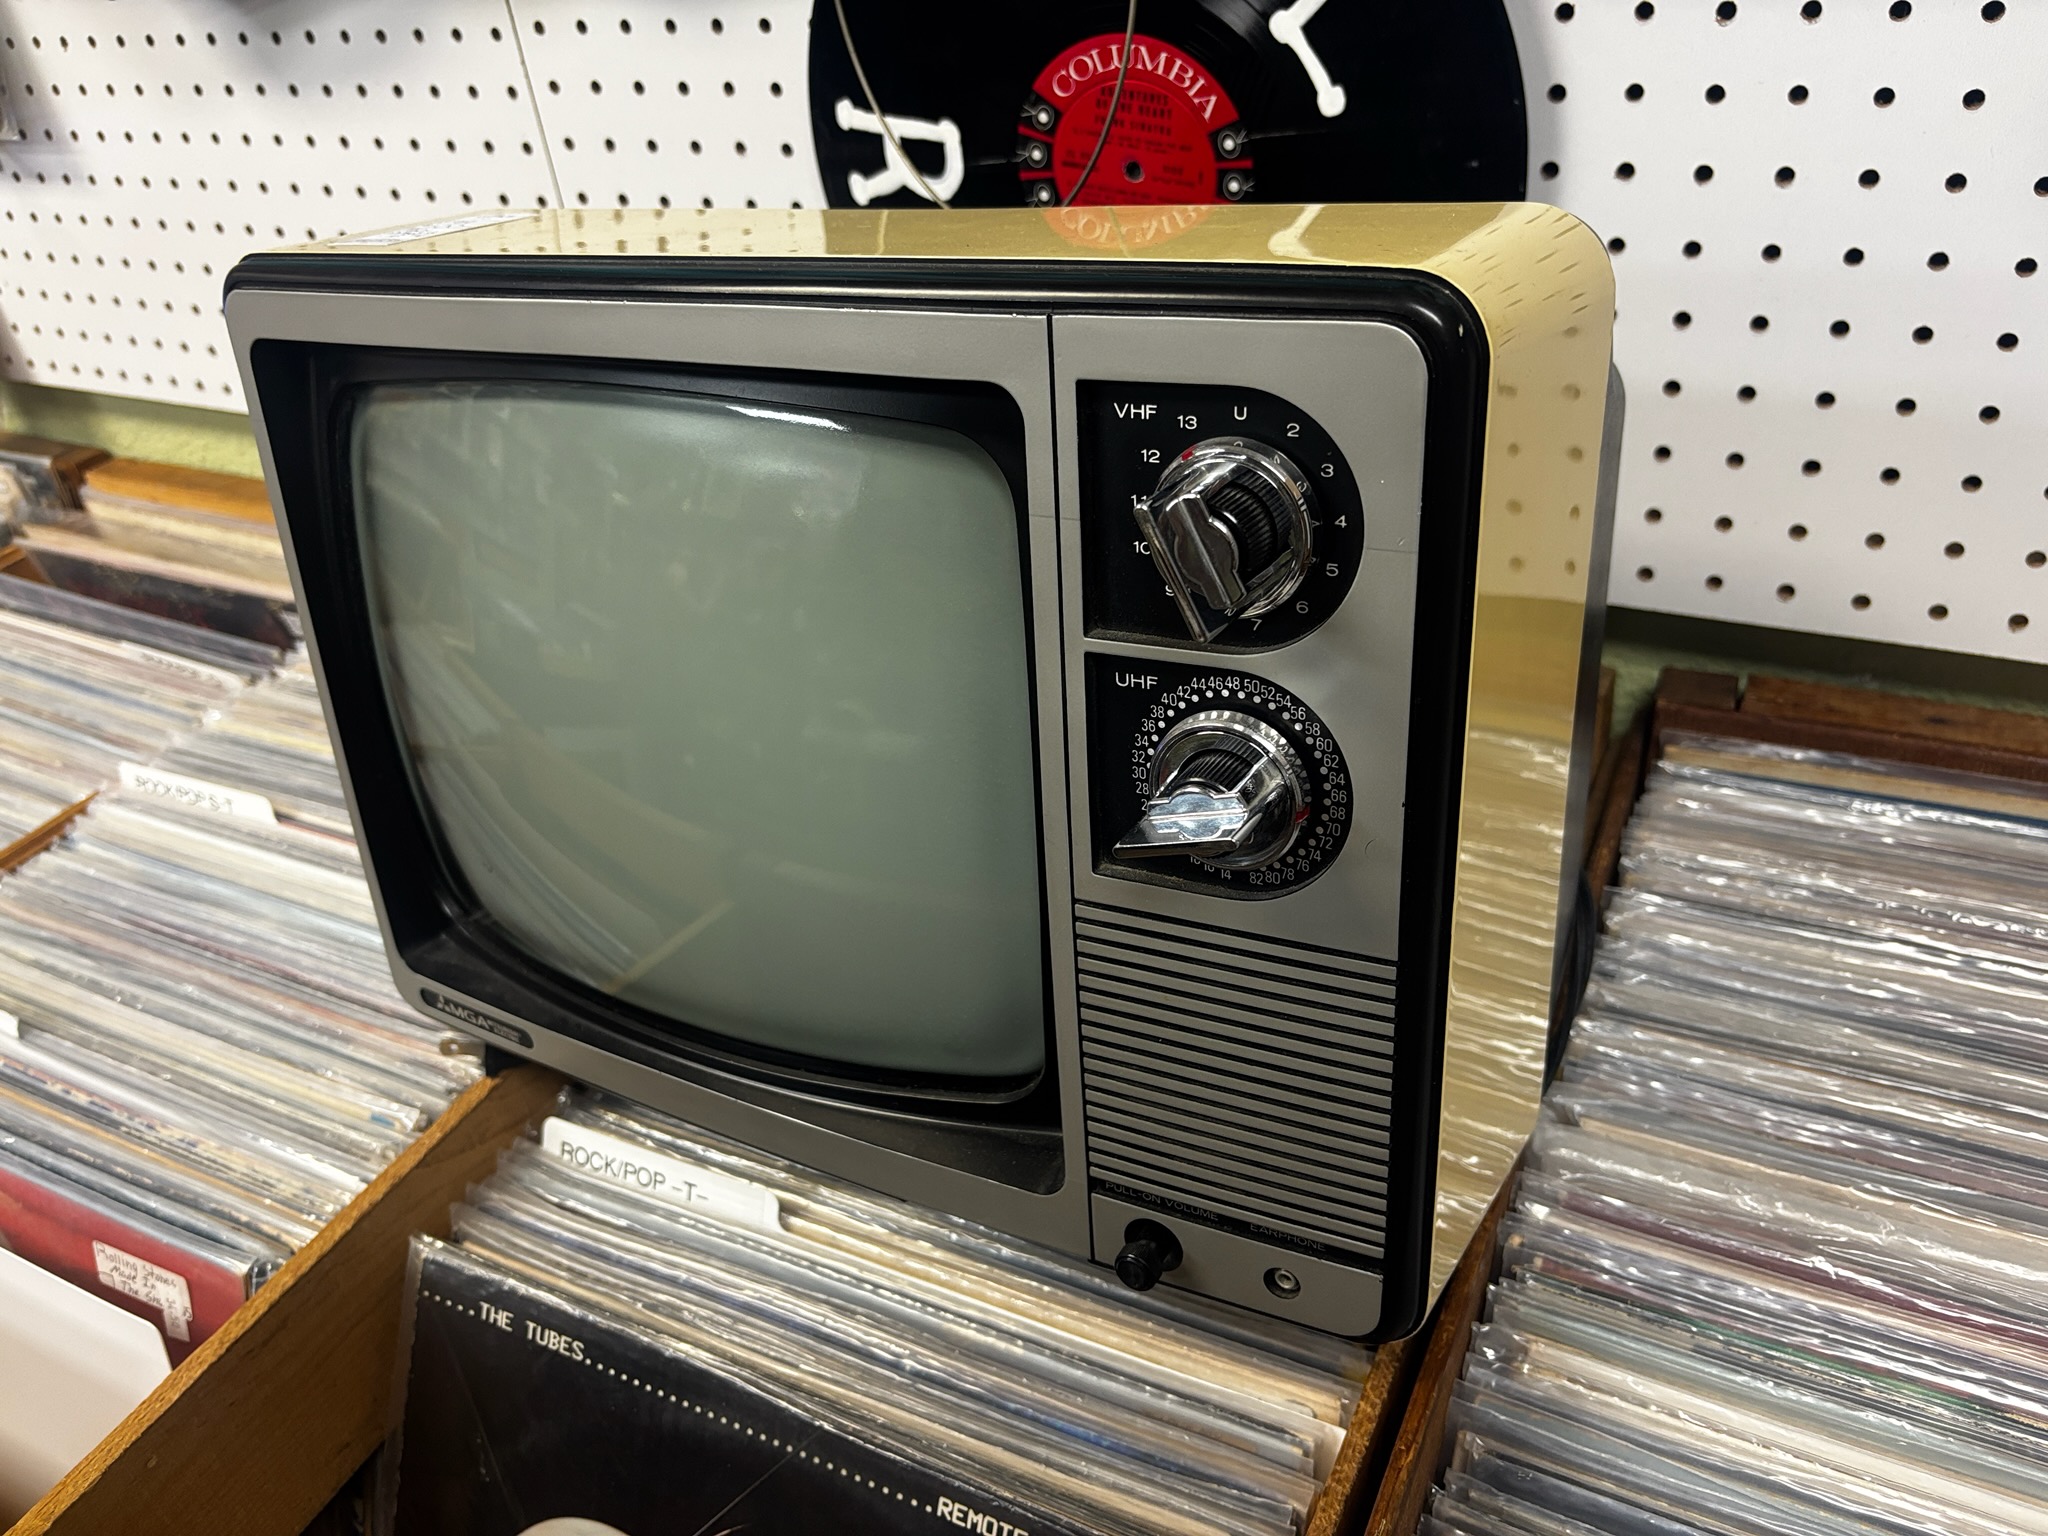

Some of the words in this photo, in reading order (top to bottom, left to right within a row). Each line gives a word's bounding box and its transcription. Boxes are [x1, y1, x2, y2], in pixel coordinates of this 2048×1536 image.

[1052, 44, 1218, 123] COLUMBIA
[834, 97, 965, 207] R
[1114, 403, 1158, 420] VHF
[1234, 406, 1247, 421] U
[1177, 415, 1198, 430] 13
[1286, 423, 1300, 438] 2
[1141, 449, 1160, 464] 12
[1320, 464, 1334, 478] 3
[1334, 515, 1348, 528] 4
[1325, 563, 1339, 577] 5
[1295, 601, 1309, 614] 6
[1250, 619, 1263, 631] 7
[1115, 672, 1158, 690] UHF
[1190, 677, 1206, 690] 44
[1207, 677, 1223, 690] 46
[1224, 676, 1240, 690] 48
[1244, 679, 1260, 693] 50
[1176, 686, 1191, 699] 42
[1260, 685, 1275, 699] 52
[1161, 693, 1177, 706] 40
[1276, 693, 1291, 707] 54
[1150, 705, 1165, 718] 38
[1290, 706, 1306, 720] 56
[1141, 718, 1156, 733] 36
[1305, 721, 1321, 736] 58
[1134, 733, 1149, 747] 34
[1316, 737, 1333, 751] 60
[1132, 750, 1146, 763] 32
[1324, 754, 1340, 768] 62
[1132, 765, 1147, 779] 30
[1329, 772, 1345, 786] 64
[1135, 782, 1149, 795] 28
[1331, 789, 1347, 803] 66
[1330, 806, 1346, 820] 68
[1325, 823, 1341, 837] 70
[1319, 835, 1333, 849] 72
[1308, 848, 1322, 862] 74
[1296, 858, 1310, 872] 76
[1221, 869, 1232, 880] 14
[1249, 872, 1264, 886] 82
[1265, 870, 1280, 884] 80
[1281, 866, 1295, 880] 78
[560, 1140, 666, 1191] ROCK/POP
[672, 1181, 710, 1203] -T-
[1105, 1181, 1161, 1205] PULL-ON
[1165, 1200, 1219, 1221] VOLUME
[1250, 1223, 1327, 1251] EARPHONE
[95, 1242, 139, 1278] Rolling
[143, 1265, 177, 1288] Stones
[110, 1265, 137, 1284] Made
[142, 1276, 156, 1290] In
[479, 1301, 515, 1333] THE
[525, 1319, 585, 1362] TUBES
